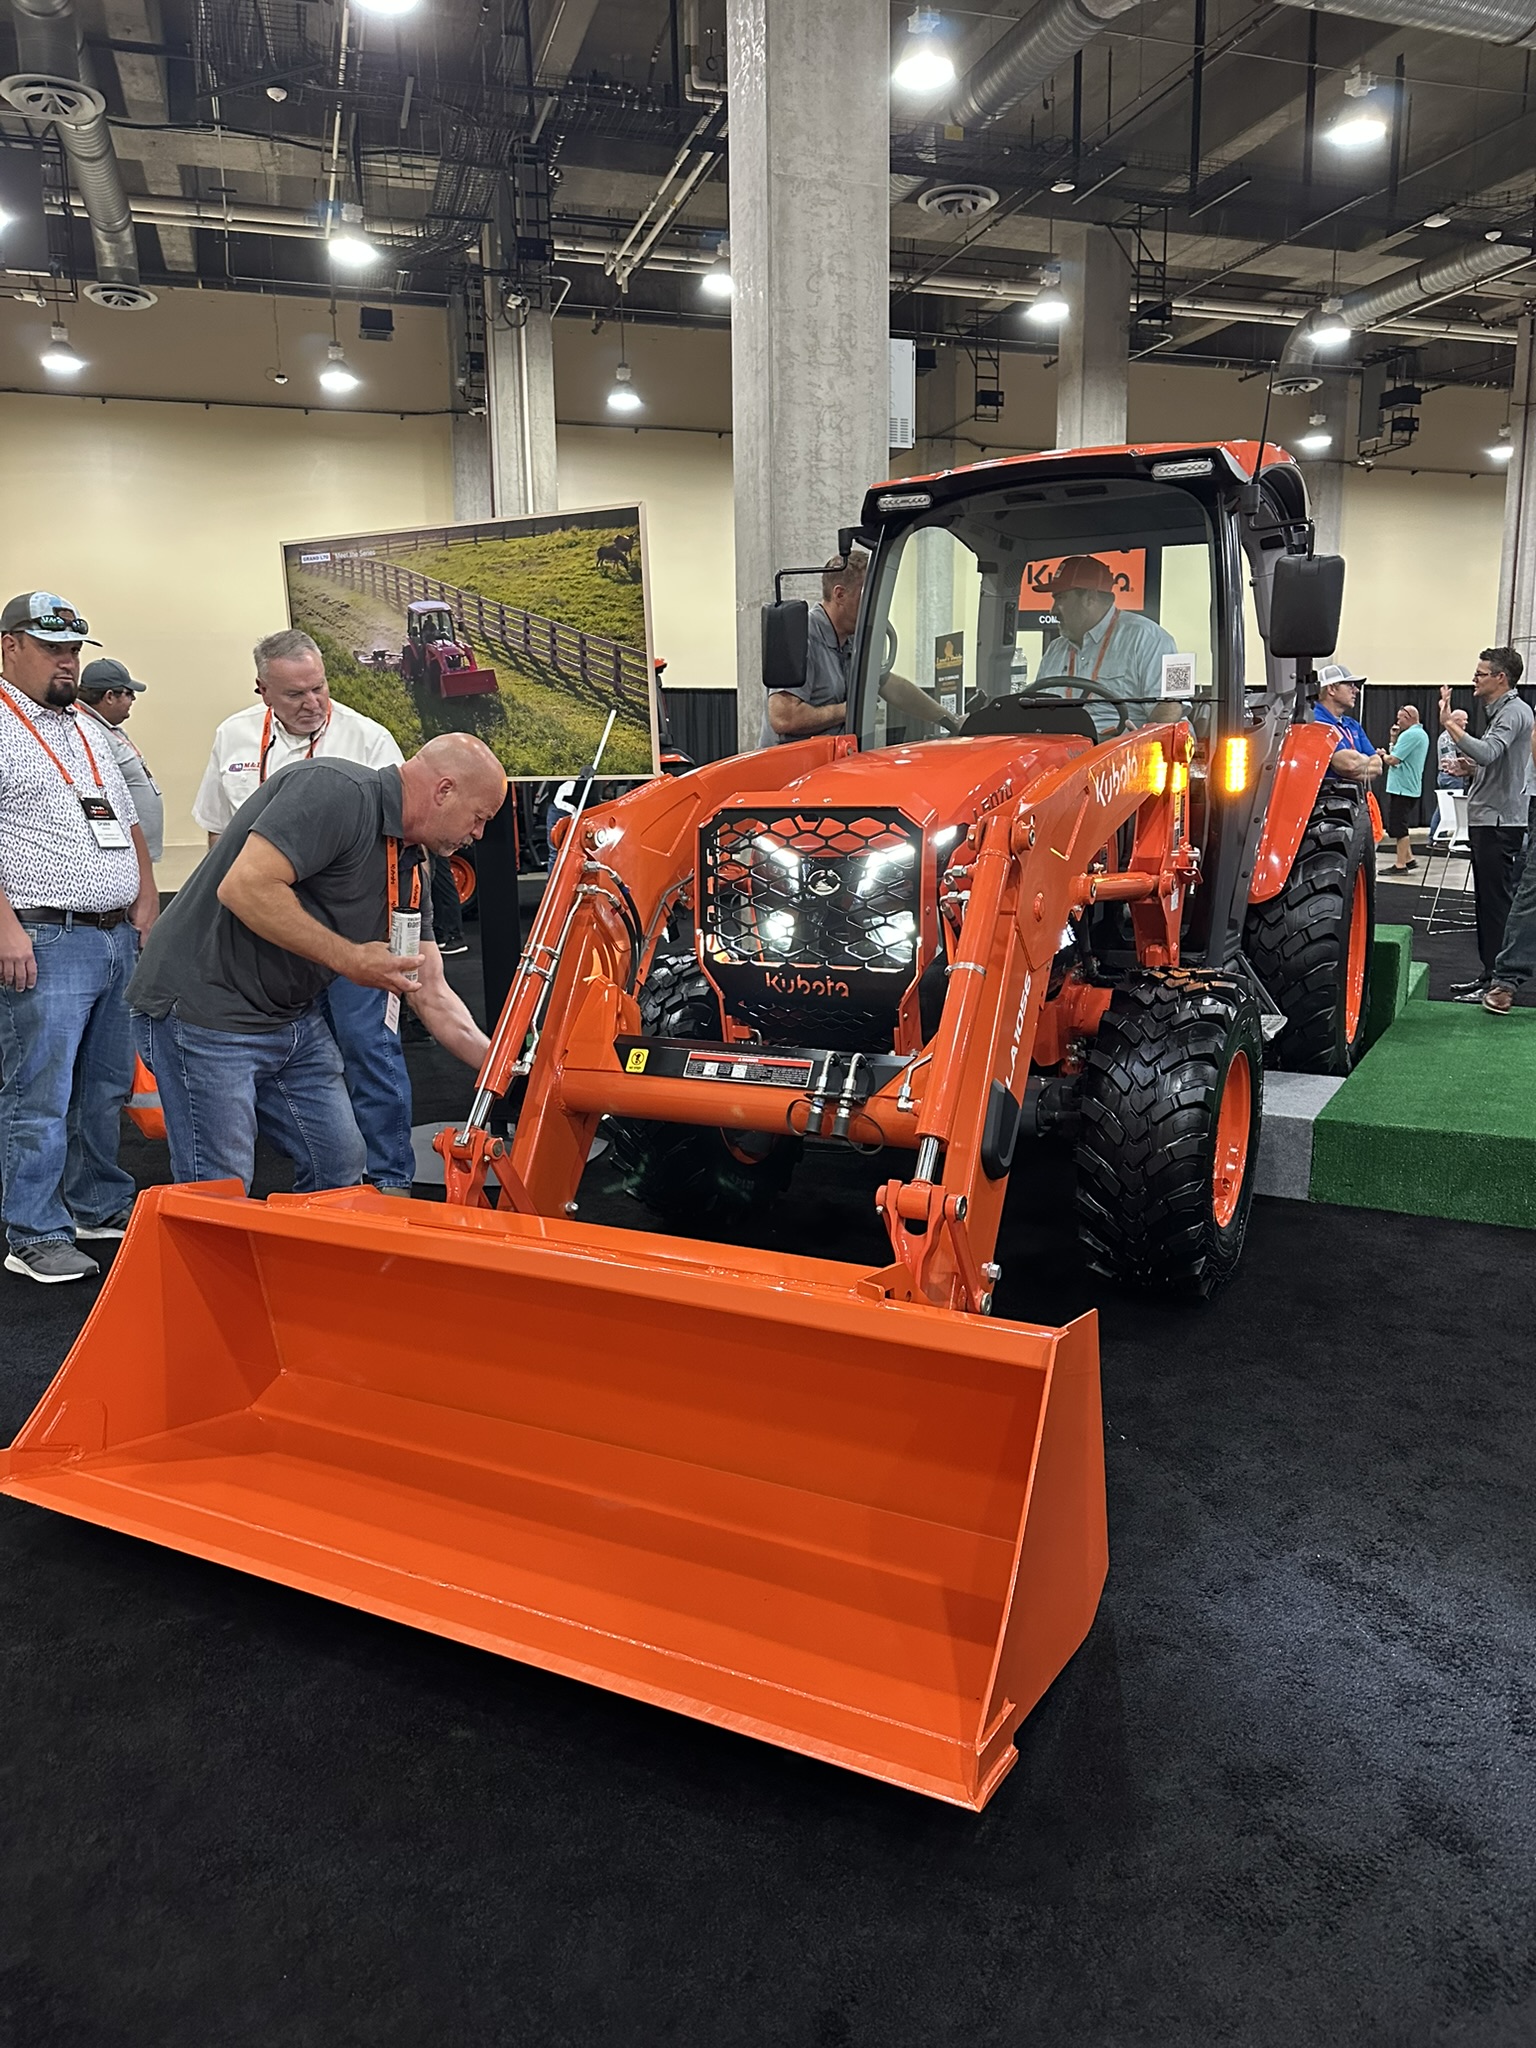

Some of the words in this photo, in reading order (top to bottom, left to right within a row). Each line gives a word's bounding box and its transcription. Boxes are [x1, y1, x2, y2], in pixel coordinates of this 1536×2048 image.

[359, 549, 376, 557] Series
[1095, 749, 1138, 807] Kubota
[765, 971, 849, 998] Kubota
